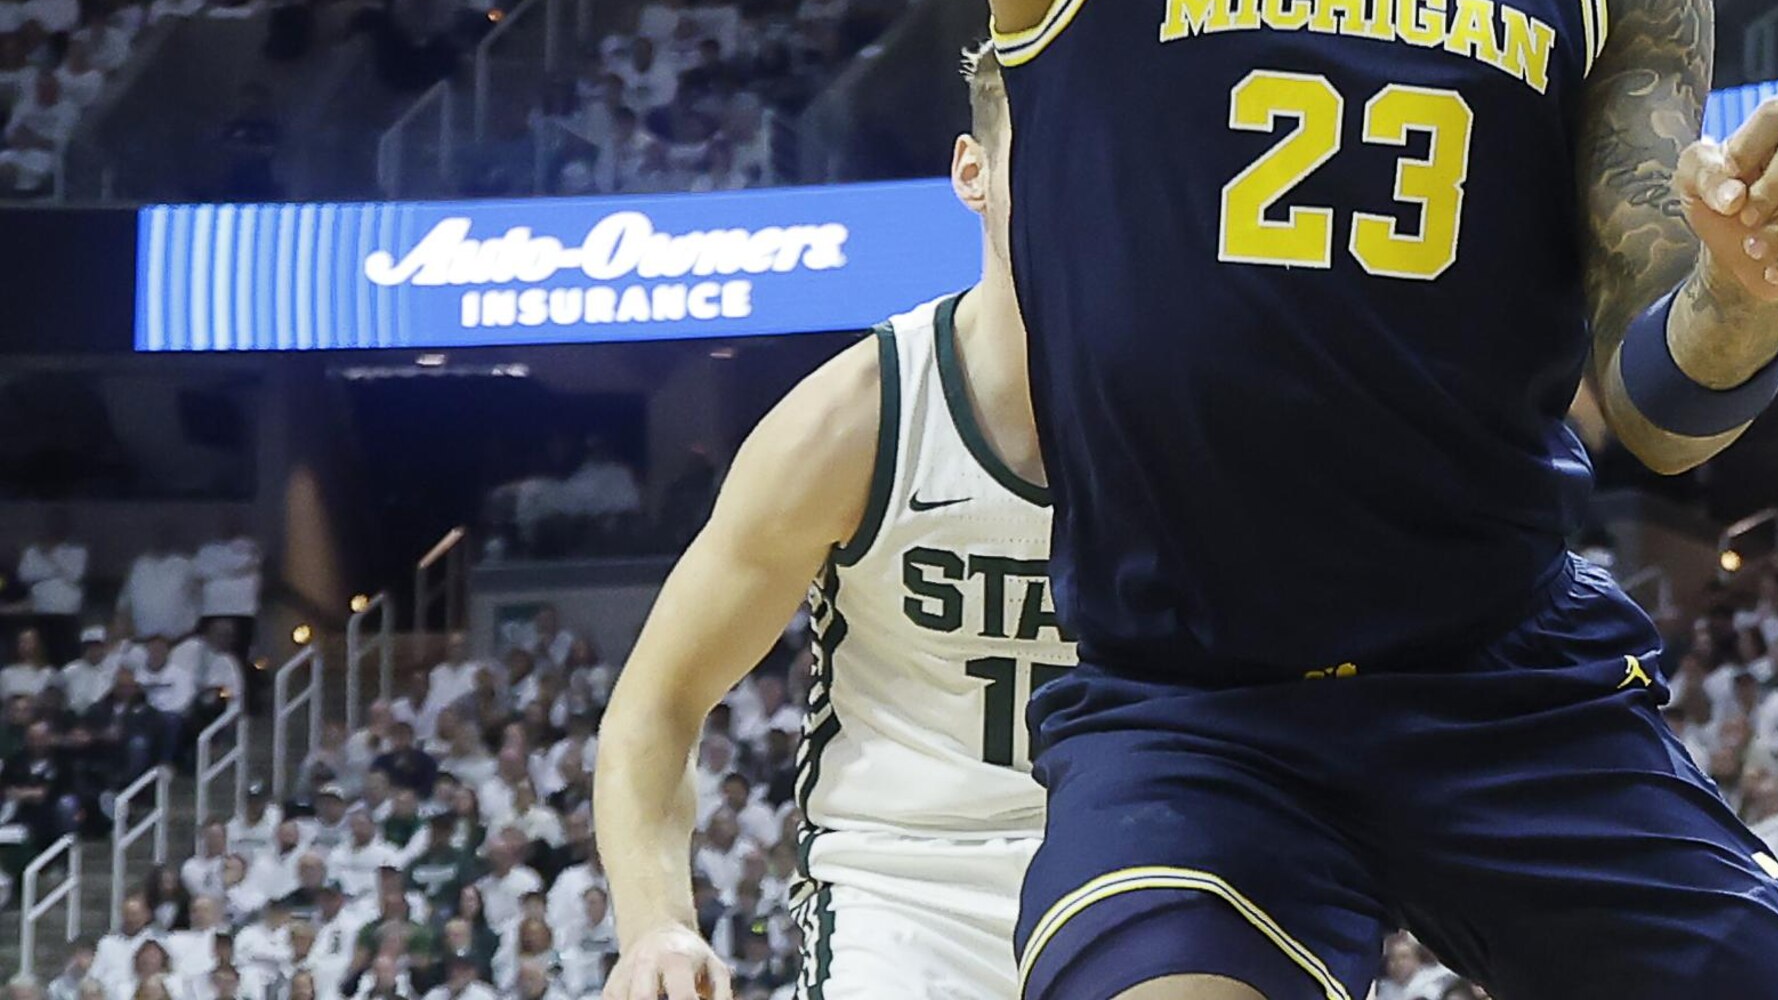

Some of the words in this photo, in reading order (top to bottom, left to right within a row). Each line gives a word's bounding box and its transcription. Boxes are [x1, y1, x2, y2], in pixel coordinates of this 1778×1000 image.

[1218, 69, 1473, 280] 23
[364, 211, 848, 286] Auto-Owners
[461, 280, 753, 328] INSURANCE
[903, 546, 1080, 643] STA
